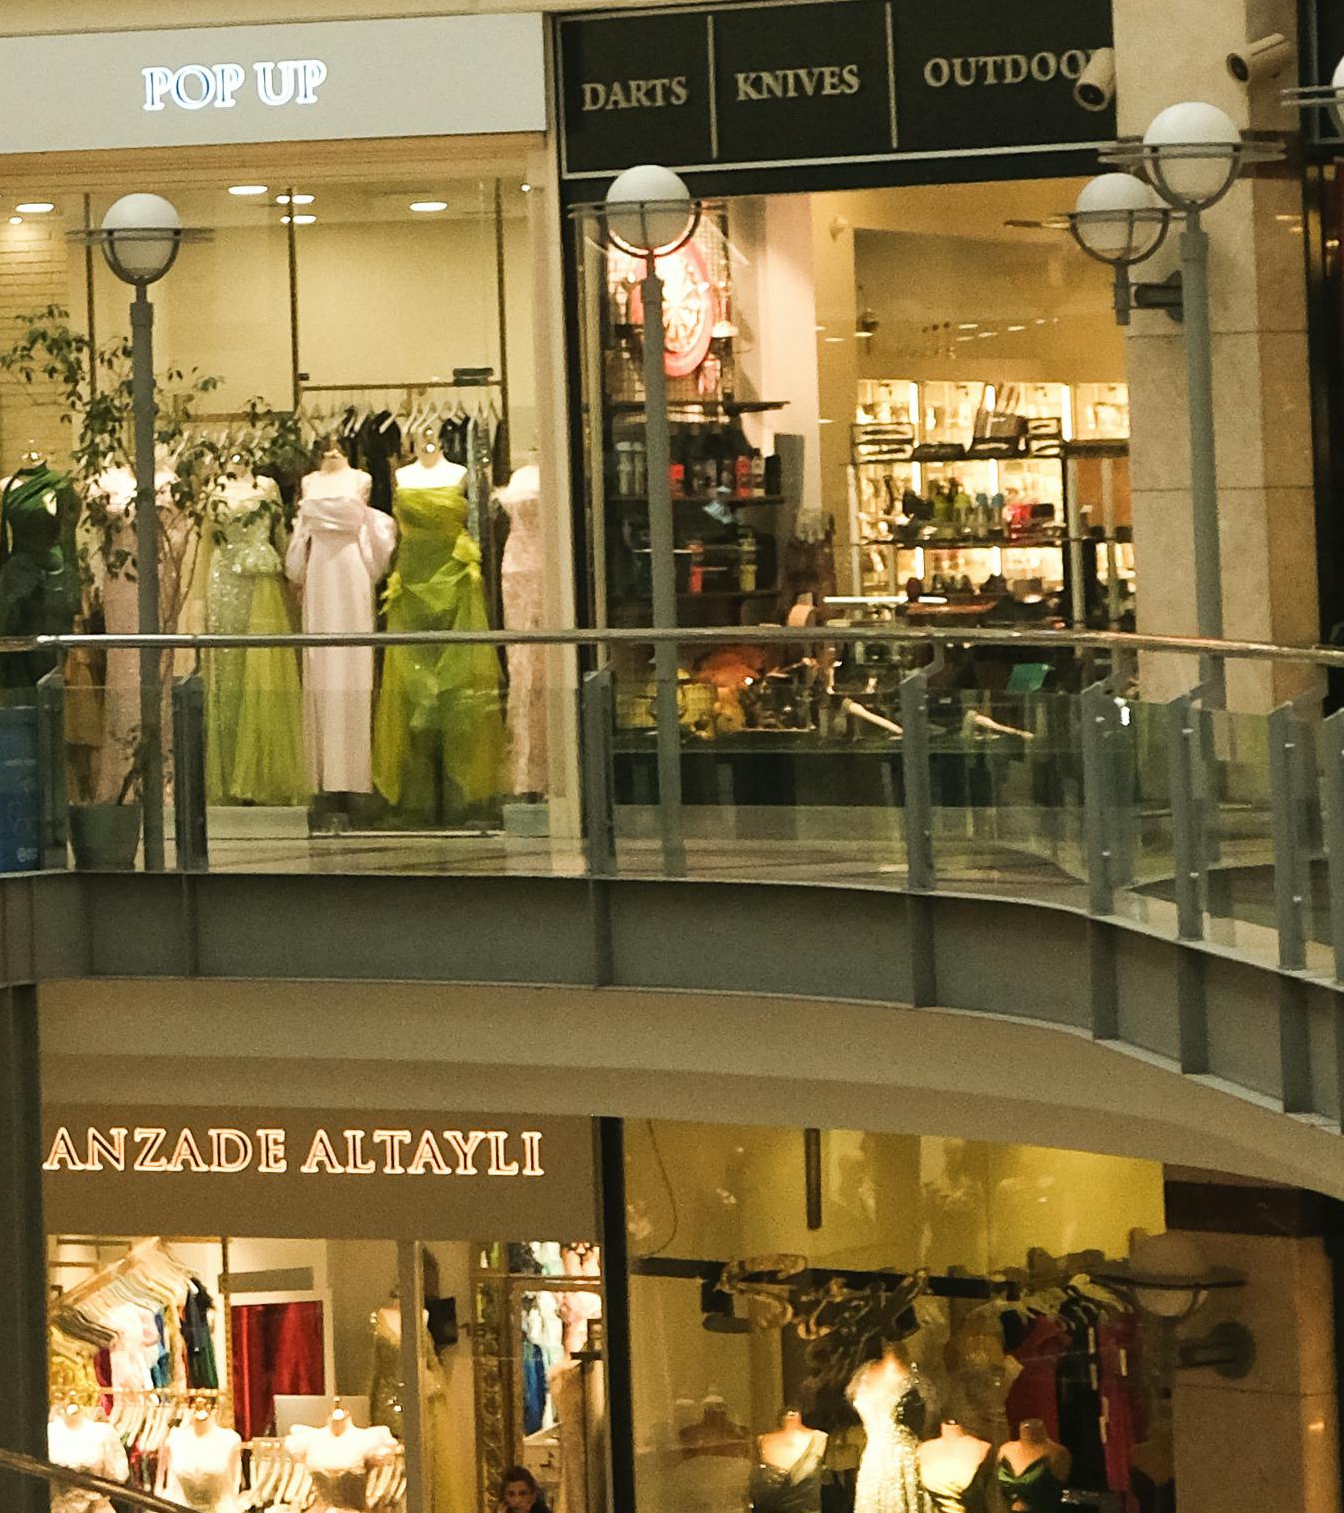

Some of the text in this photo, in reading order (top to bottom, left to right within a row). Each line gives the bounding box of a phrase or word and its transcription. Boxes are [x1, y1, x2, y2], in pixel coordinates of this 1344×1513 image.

[141, 59, 328, 111] POP UP
[735, 64, 863, 102] KNIVES
[923, 49, 1098, 87] OUTDOO
[582, 76, 689, 113] DARTS
[42, 1126, 546, 1178] ANZADE ALTAYLI
